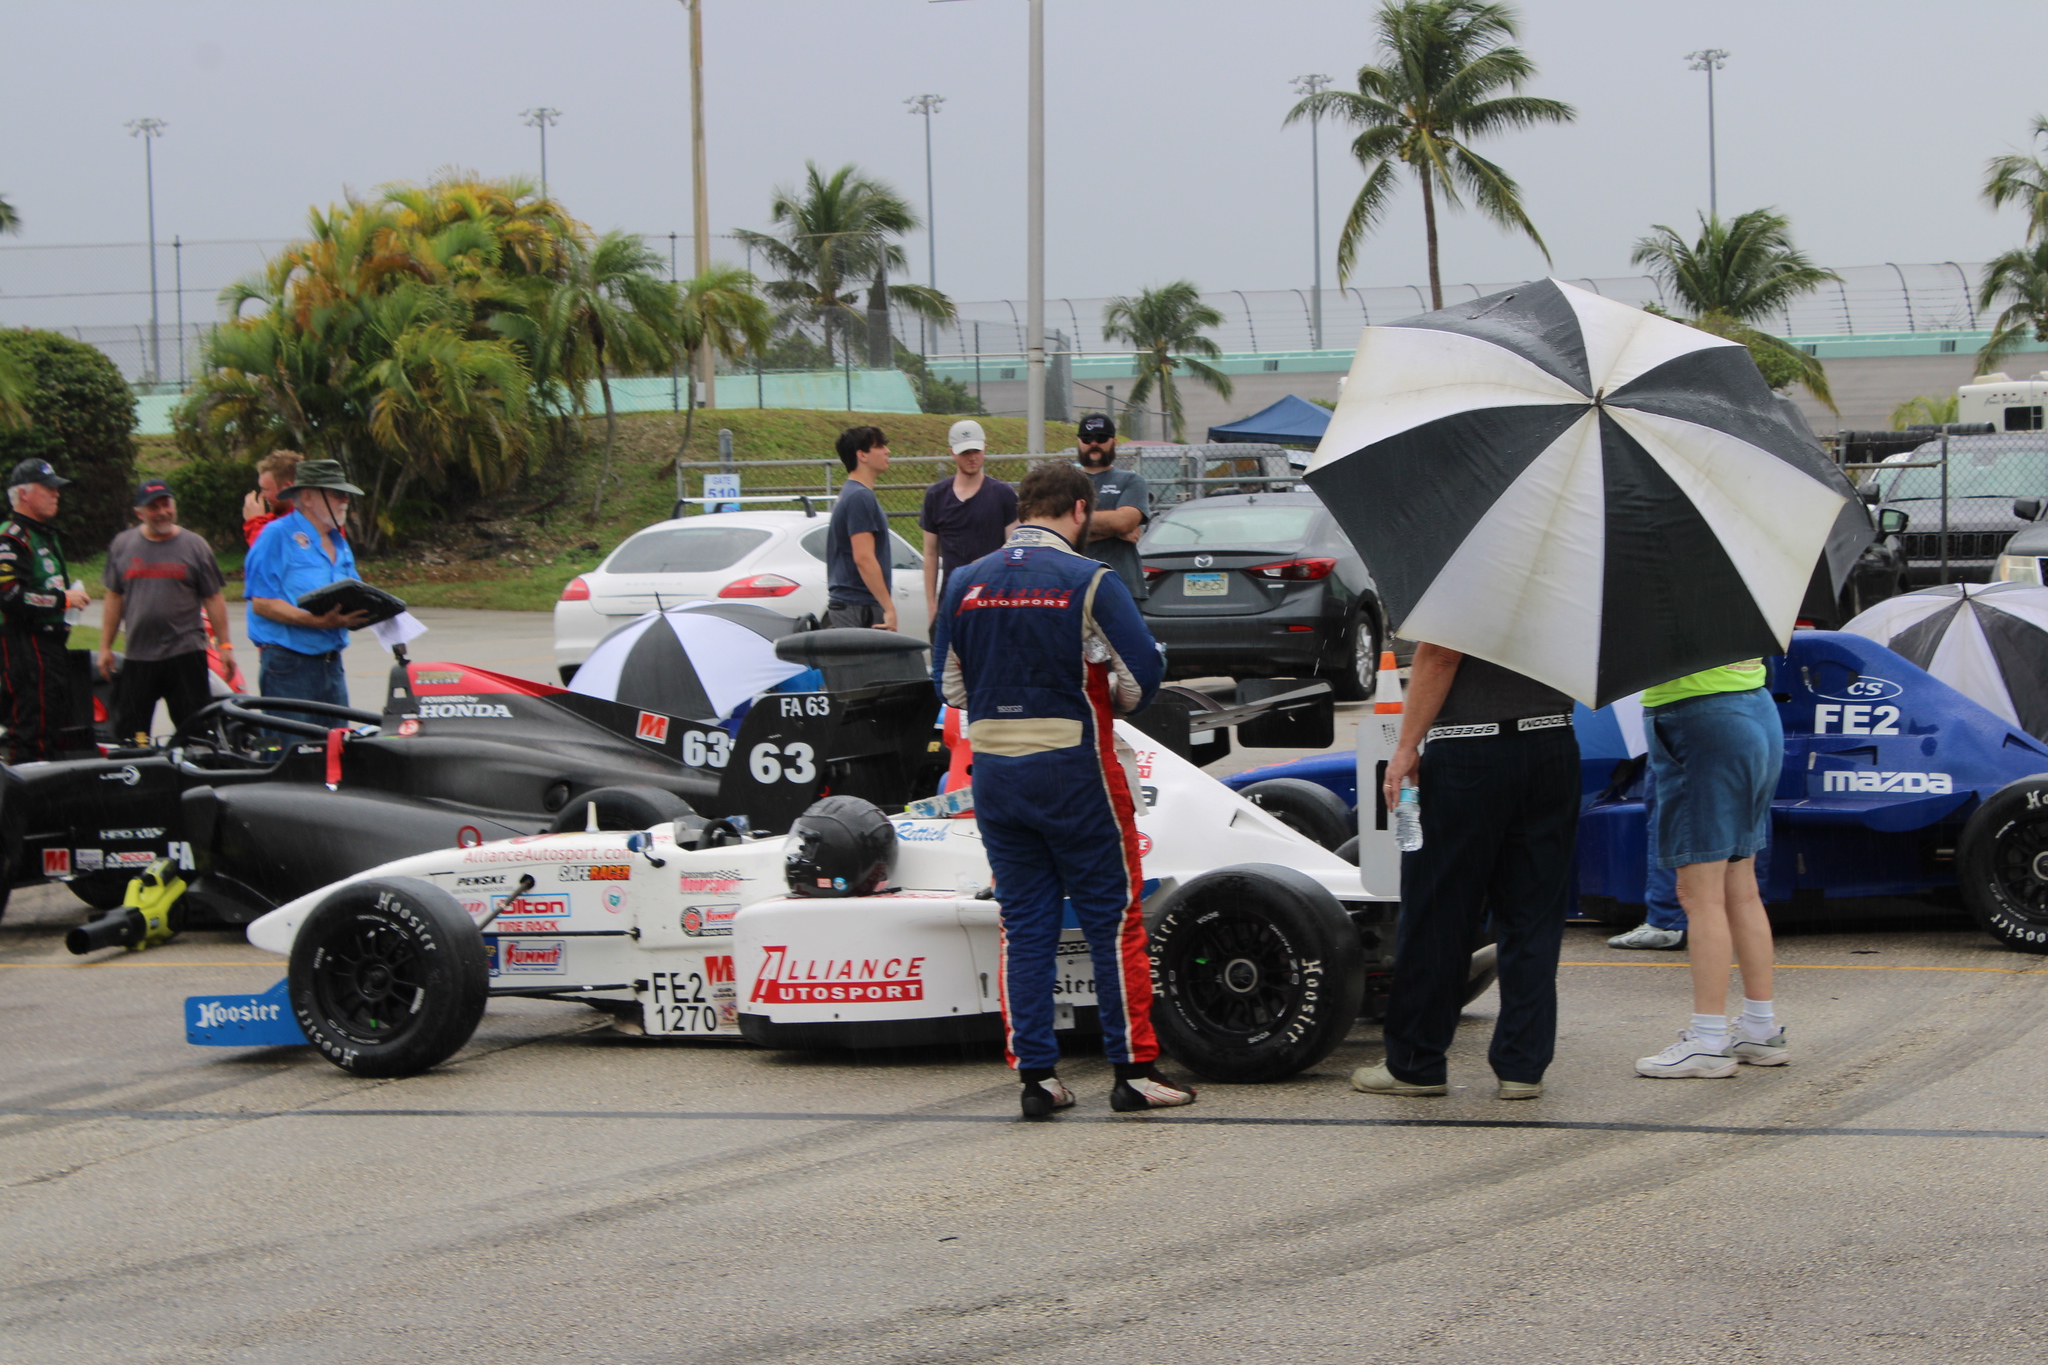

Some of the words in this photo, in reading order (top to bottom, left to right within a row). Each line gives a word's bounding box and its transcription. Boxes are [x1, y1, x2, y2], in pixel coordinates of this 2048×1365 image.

[708, 488, 736, 498] 510
[418, 704, 513, 718] HONDA
[780, 698, 803, 717] FA
[806, 696, 830, 716] 63
[1814, 704, 1901, 735] FE2
[683, 730, 730, 768] 63
[750, 742, 816, 784] 63
[464, 847, 636, 864] AllianceAutosport.com
[457, 875, 507, 886] PENSKE
[373, 891, 437, 951] Hoosier
[496, 921, 523, 932] TIRE
[526, 920, 560, 932] RACK
[1990, 913, 2048, 944] oosier
[653, 972, 706, 1003] FE2
[195, 999, 281, 1028] Hoosier
[656, 1005, 717, 1031] 1270
